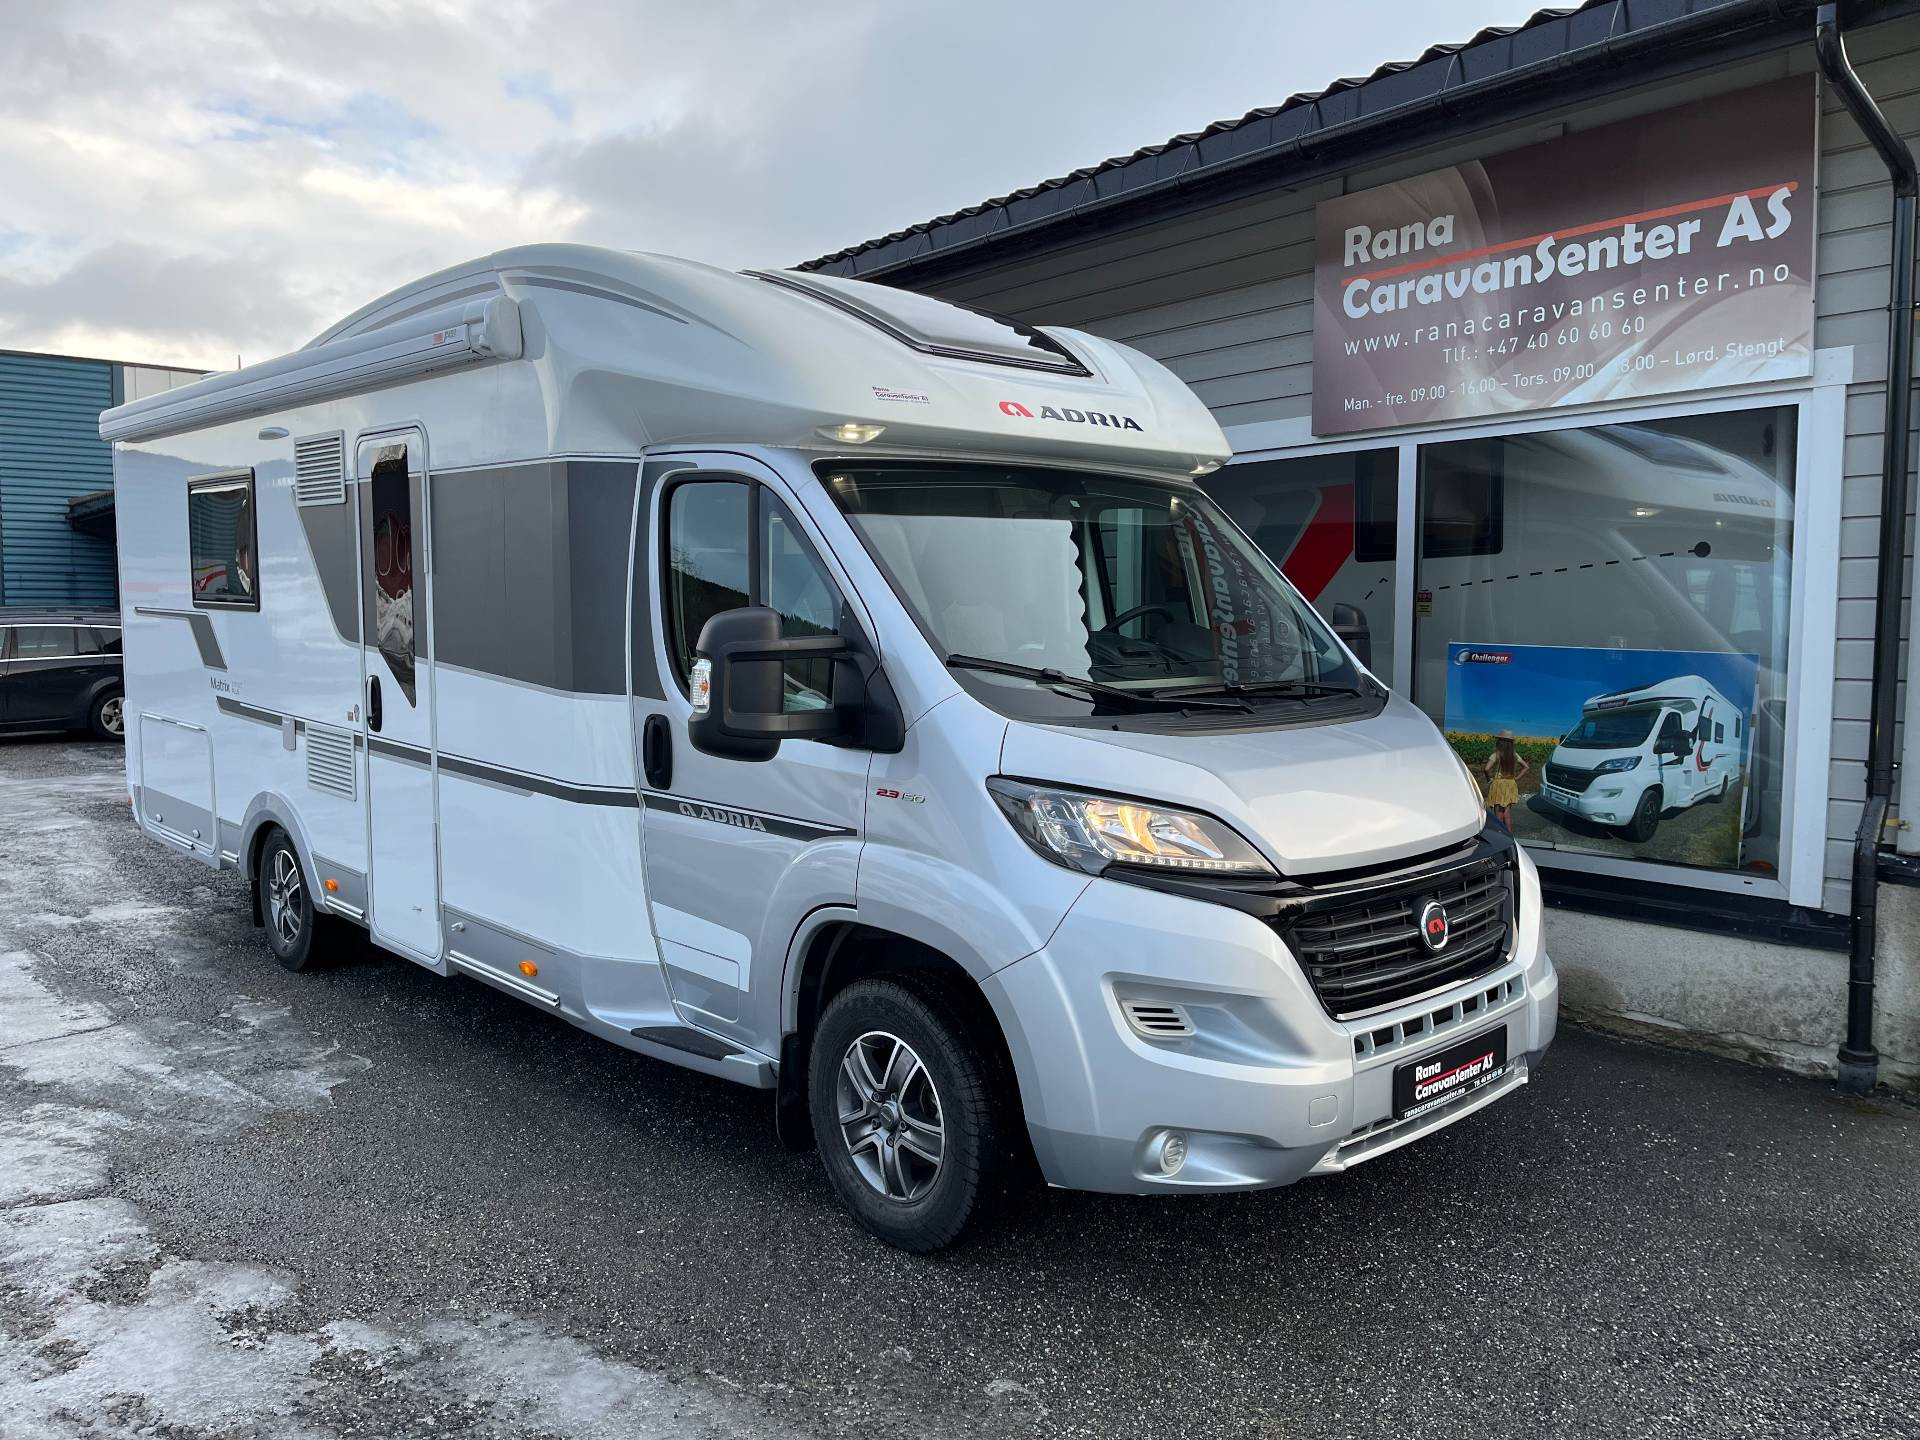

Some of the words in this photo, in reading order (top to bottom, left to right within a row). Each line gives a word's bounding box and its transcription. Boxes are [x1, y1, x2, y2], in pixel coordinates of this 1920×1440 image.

[1342, 218, 1702, 319] CaravanSenter
[1716, 187, 1793, 248] AS
[1343, 214, 1455, 268] Rana
[1345, 262, 1790, 356] www.ranacaravansenter.no
[1442, 347, 1479, 365] Tlf.:
[1487, 337, 1519, 357] +47
[1526, 331, 1549, 351] 40
[1557, 326, 1580, 346] 60
[1589, 321, 1612, 341] 60
[1622, 315, 1646, 335] 60
[1344, 396, 1374, 412] Man.
[1385, 393, 1407, 407] fre.
[1410, 385, 1445, 403] 09.00
[1460, 377, 1496, 396] 16.00
[1513, 368, 1548, 388] Tors.
[1553, 362, 1594, 382] 09.00
[1615, 354, 1655, 373] 8.00
[1675, 346, 1718, 366] Lørd.
[1726, 337, 1785, 358] Stengt
[1040, 405, 1145, 432] ADRIA
[700, 807, 767, 832] ADRIA
[1415, 1062, 1441, 1082] Rana
[1415, 1062, 1482, 1100] CaravanSenter
[1482, 1053, 1494, 1071] AS
